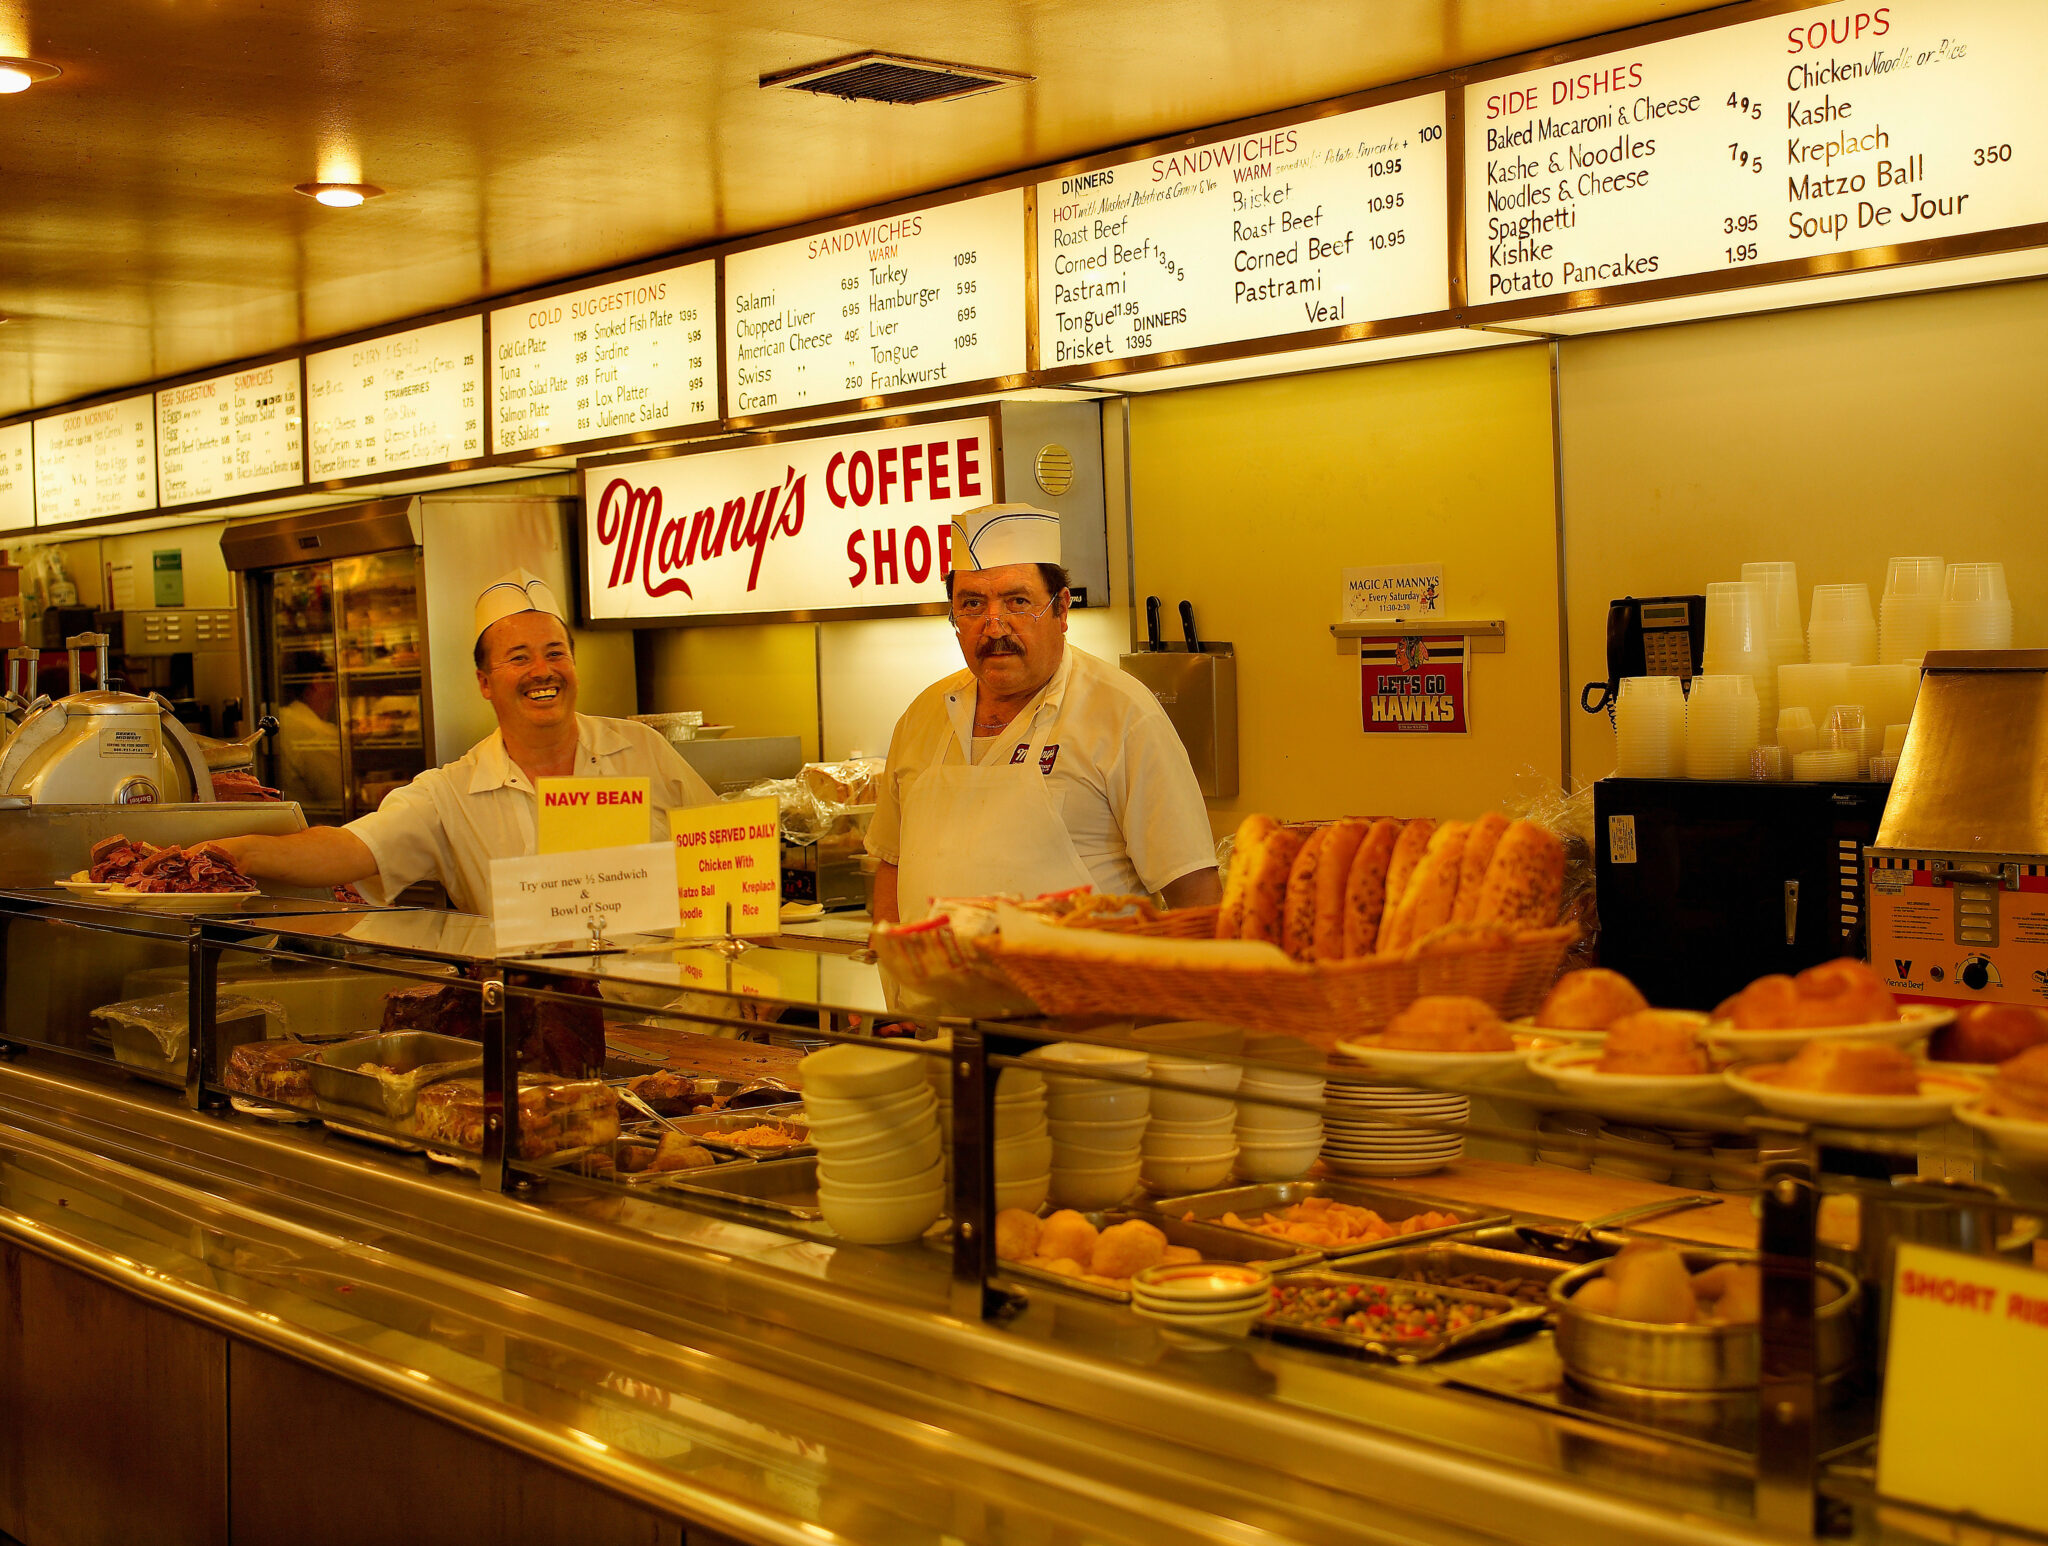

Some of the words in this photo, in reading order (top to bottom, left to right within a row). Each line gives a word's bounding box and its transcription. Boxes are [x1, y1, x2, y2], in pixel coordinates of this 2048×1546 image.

[1787, 8, 1890, 54] SOUPS
[1787, 60, 1862, 92] Chicken
[1917, 49, 1936, 63] or
[1487, 82, 1537, 119] SIDE
[1553, 63, 1642, 105] DISHES
[1488, 127, 1533, 152] Baked
[1539, 113, 1612, 142] Macaroni
[1618, 107, 1630, 125] &
[1634, 93, 1700, 121] Cheese
[1788, 99, 1852, 129] Kashe
[1418, 125, 1442, 144] 100
[1788, 126, 1889, 165] Kreplach
[1153, 130, 1297, 182] SANDWICHES
[1488, 157, 1538, 185] Kashe
[1550, 153, 1562, 173] &
[1570, 138, 1655, 168] Noodles
[1974, 144, 2011, 167] 350
[1234, 163, 1271, 184] WARM
[1368, 159, 1402, 177] 10.95
[1789, 173, 1866, 202] Matzo
[1878, 155, 1923, 186] Ball
[1063, 171, 1113, 194] DINNERS
[1488, 185, 1550, 212] Noodles
[1559, 181, 1573, 200] &
[1579, 169, 1649, 197] Cheese
[1054, 204, 1079, 223] HOT
[1368, 193, 1404, 213] 10.95
[1234, 223, 1275, 242] Roast
[1282, 206, 1323, 232] Beef
[1489, 207, 1576, 243] Spaghetti
[1789, 209, 1848, 241] Soup
[1858, 202, 1891, 228] De
[1901, 191, 1968, 222] Jour
[808, 217, 922, 259] SANDWICHES
[1054, 224, 1088, 248] Roast
[1094, 216, 1128, 239] Beef
[869, 245, 898, 262] WARM
[954, 251, 976, 267] 1095
[1055, 253, 1107, 276] Corned
[1114, 239, 1149, 264] Beef
[1235, 246, 1297, 273] Corned
[1308, 232, 1354, 261] Beef
[1369, 230, 1405, 251] 10.95
[1490, 241, 1553, 267] Kishke
[1726, 244, 1758, 264] 1.95
[841, 278, 859, 290] 695
[870, 265, 908, 286] Turkey
[1490, 269, 1553, 295] Potato
[1563, 254, 1658, 284] Pancakes
[957, 281, 976, 295] 595
[1055, 273, 1126, 304] Pastrami
[1235, 269, 1322, 304] Pastrami
[529, 308, 562, 329] COLD
[572, 283, 666, 319] SUGGESTIONS
[736, 289, 775, 314] Salami
[842, 304, 860, 318] 695
[869, 287, 940, 312] Hamburger
[1305, 297, 1345, 324] Veal
[595, 321, 626, 339] Smoked
[630, 316, 646, 333] Fish
[650, 311, 673, 328] Plate
[680, 310, 697, 321] 1395
[736, 312, 782, 340] Chopped
[788, 310, 815, 328] Liver
[958, 307, 976, 322] 695
[1056, 309, 1114, 335] Tongue
[1113, 302, 1139, 316] 11.95
[1134, 308, 1187, 332] DINNERS
[870, 320, 898, 338] Liver
[499, 341, 512, 360] Cold
[515, 342, 526, 355] Cut
[528, 339, 547, 354] Plate
[595, 343, 629, 362] Sardine
[738, 340, 784, 361] American
[790, 331, 832, 351] Cheese
[954, 334, 977, 349] 1095
[1057, 339, 1113, 362] Brisket
[1126, 336, 1152, 349] 1395
[871, 343, 918, 364] Tongue
[500, 365, 520, 380] Tuna
[596, 368, 617, 384] Fruit
[738, 368, 771, 386] Swiss
[846, 376, 862, 389] 250
[871, 362, 947, 390] Frankwurst
[500, 383, 526, 401] Salmon
[529, 378, 547, 396] Salad
[550, 377, 567, 393] Plate
[596, 390, 613, 406] Lox
[618, 385, 648, 401] Platter
[689, 378, 703, 391] 995
[500, 405, 526, 423] Salmon
[530, 402, 549, 418] Plate
[739, 392, 777, 410] Cream
[597, 412, 635, 428] Julienne
[640, 400, 669, 422] Salad
[501, 428, 516, 446] Egg
[518, 424, 539, 442] Salad
[825, 437, 981, 509] COFFEE
[598, 465, 807, 600] Manny's
[1350, 580, 1380, 591] MAGIC
[1383, 579, 1393, 589] AT
[1396, 576, 1439, 588] MANNY'S
[1369, 593, 1387, 601] Every
[1390, 591, 1419, 601] Saturday
[1380, 604, 1410, 612] 11:30-2:30
[1378, 676, 1421, 695] LET'S
[1425, 675, 1445, 694] GO
[1371, 695, 1454, 722] HAWKS
[545, 792, 590, 806] NAVY
[596, 791, 643, 805] BEAN
[677, 832, 706, 848] SOUPS
[710, 827, 745, 844] SERVED
[749, 824, 775, 839] DAILY
[699, 859, 732, 872] Chicken
[735, 856, 754, 869] With
[520, 881, 538, 892] Try
[541, 880, 559, 889] our
[562, 878, 581, 886] new
[598, 869, 647, 882] Sandwich
[702, 885, 715, 896] Ball
[742, 880, 775, 894] Kreplach
[580, 890, 590, 899] &
[551, 905, 578, 917] Bowl
[581, 902, 592, 913] of
[595, 902, 621, 914] Soup
[742, 904, 759, 916] Rice
[1884, 978, 1907, 988] Vienna
[1909, 981, 1924, 991] Beef
[1902, 1270, 1997, 1314] SHORT
